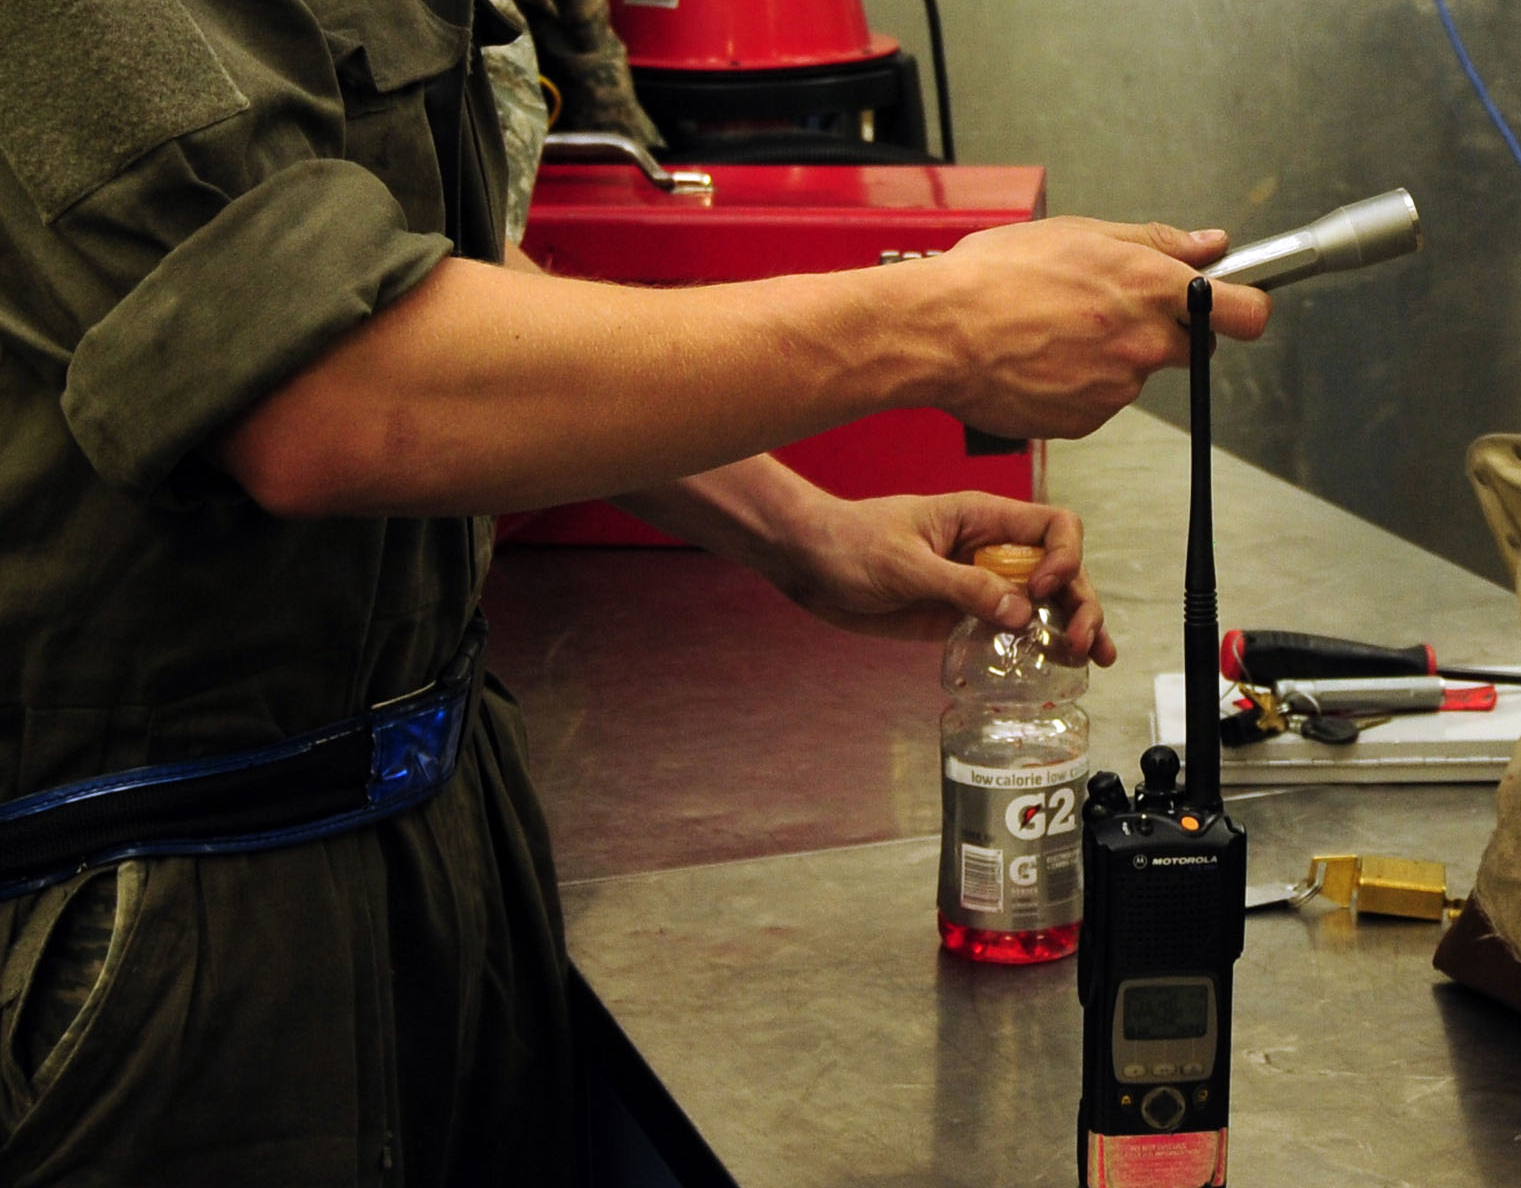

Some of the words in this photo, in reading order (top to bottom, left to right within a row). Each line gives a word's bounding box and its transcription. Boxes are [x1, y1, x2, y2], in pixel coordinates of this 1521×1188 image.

[971, 769, 993, 785] low
[995, 773, 1042, 787] calorie
[1004, 787, 1077, 841] G2
[1151, 855, 1218, 867] MOTOROLA
